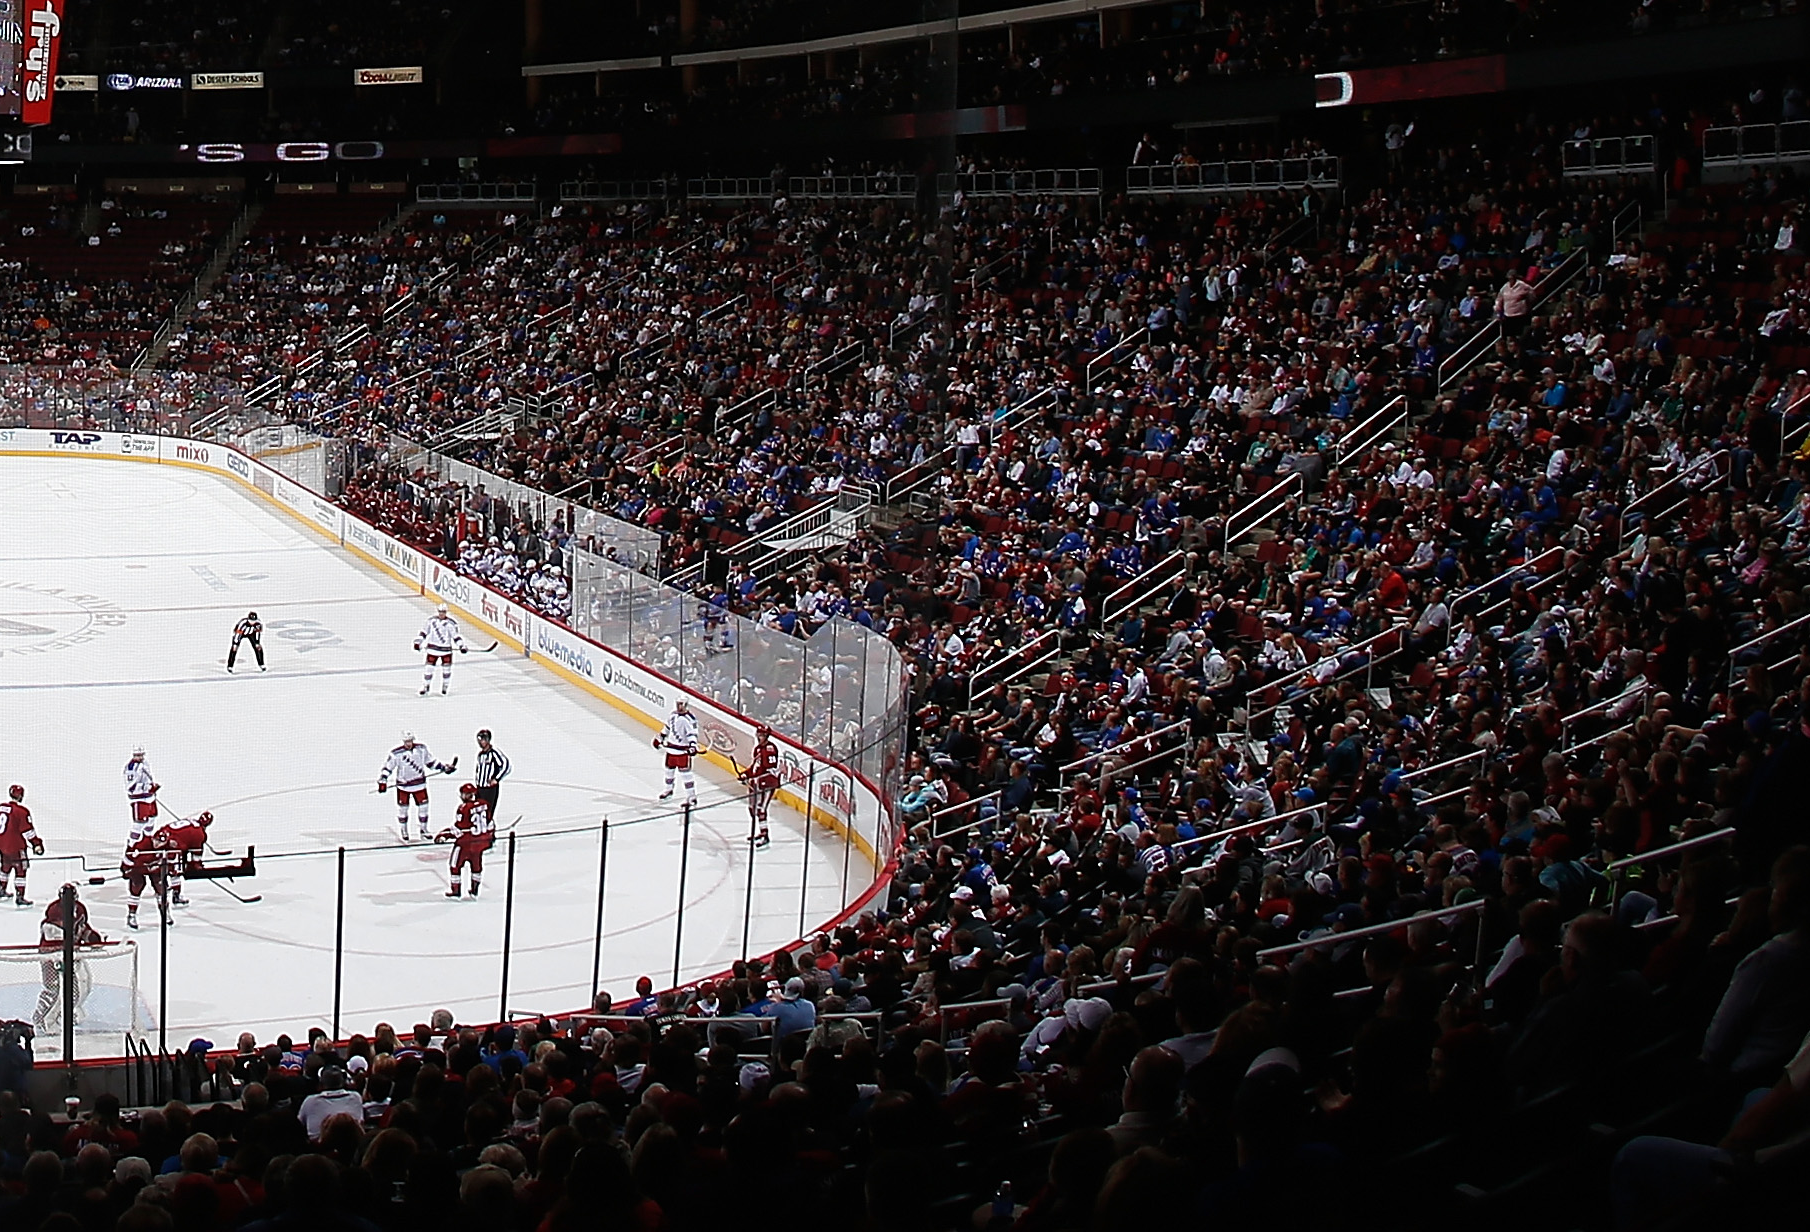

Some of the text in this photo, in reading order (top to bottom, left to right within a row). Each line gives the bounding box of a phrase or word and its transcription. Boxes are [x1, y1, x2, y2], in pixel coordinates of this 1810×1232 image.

[135, 76, 183, 89] ARIZONA
[275, 141, 385, 163] GO
[49, 432, 103, 445] TAP
[440, 575, 470, 605] pepsi
[538, 625, 594, 678] bluemedia
[614, 669, 665, 708] phxbmw.com
